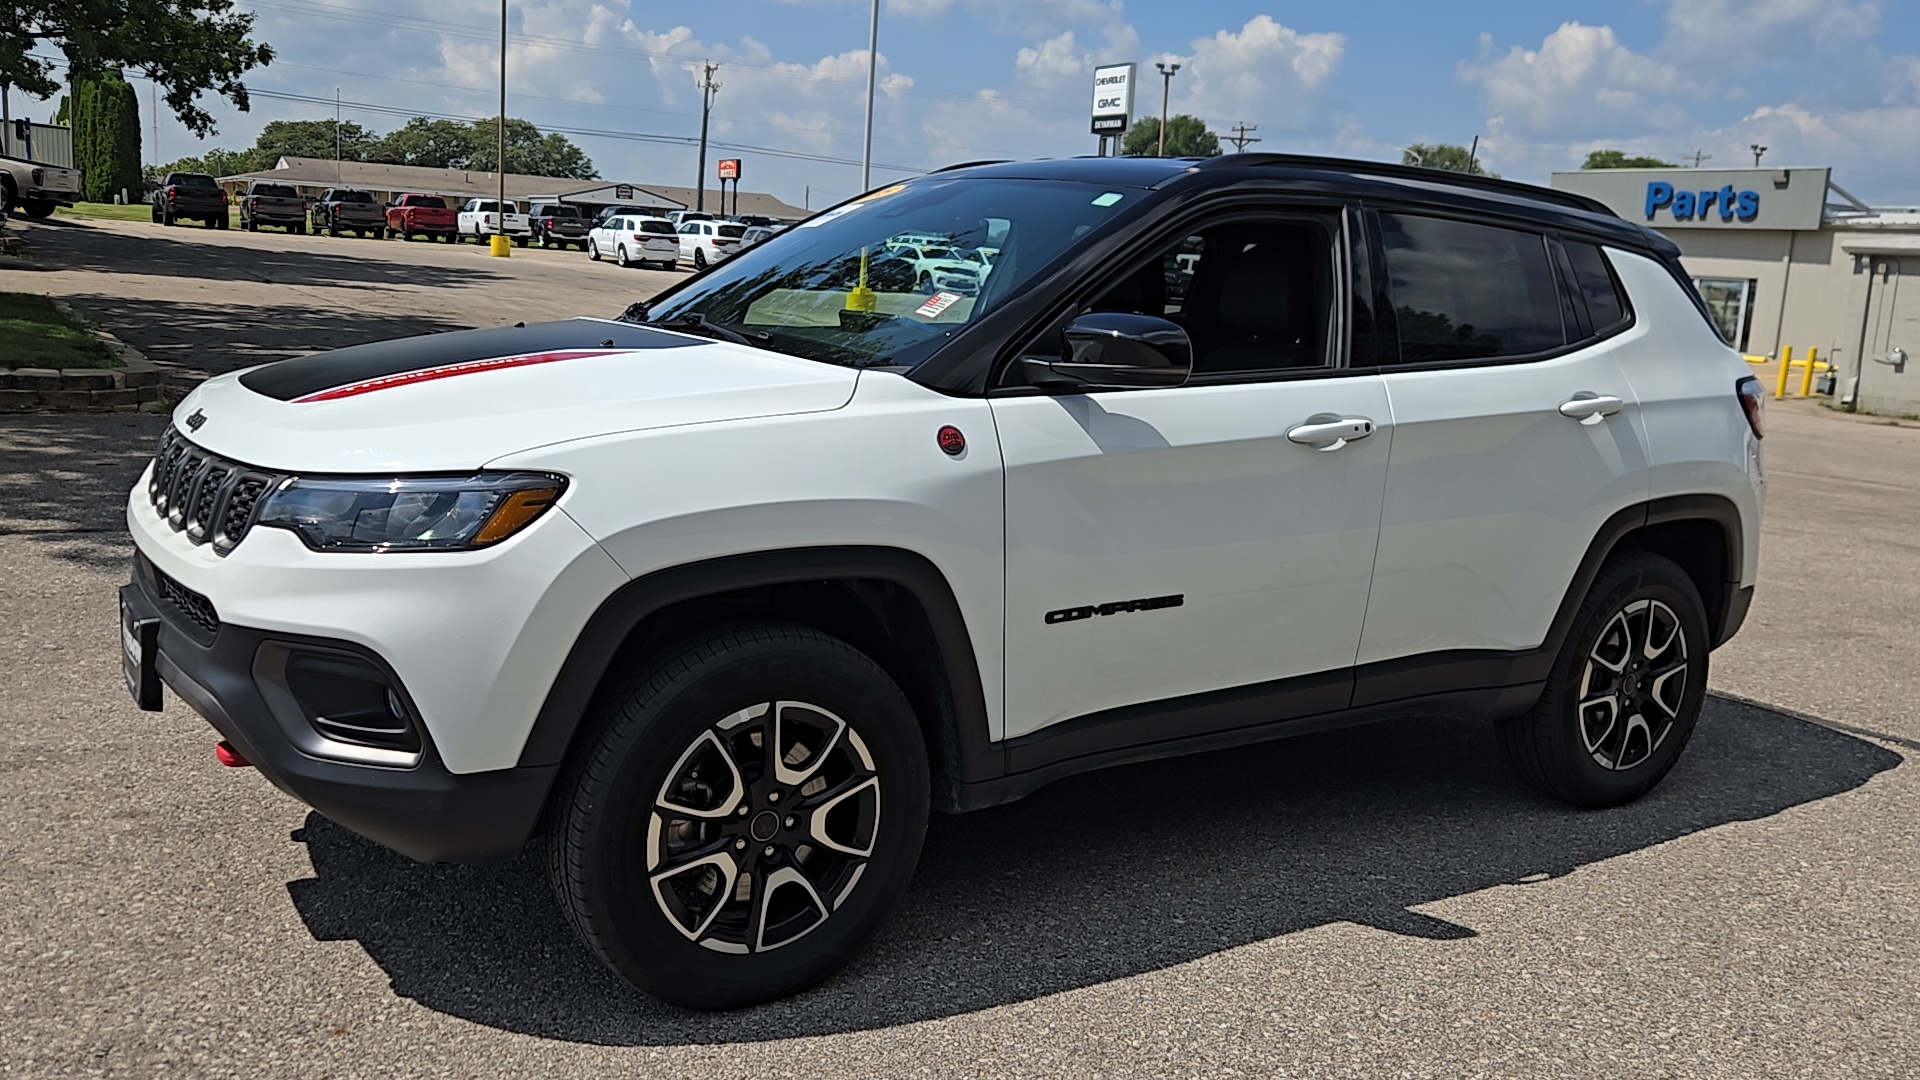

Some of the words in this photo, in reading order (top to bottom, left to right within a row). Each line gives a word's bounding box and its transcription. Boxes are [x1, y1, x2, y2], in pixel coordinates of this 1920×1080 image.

[1096, 75, 1126, 86] CHEVROLET
[1098, 97, 1121, 108] GMC
[1644, 181, 1760, 221] Parts
[1045, 593, 1184, 625] COMPASS
